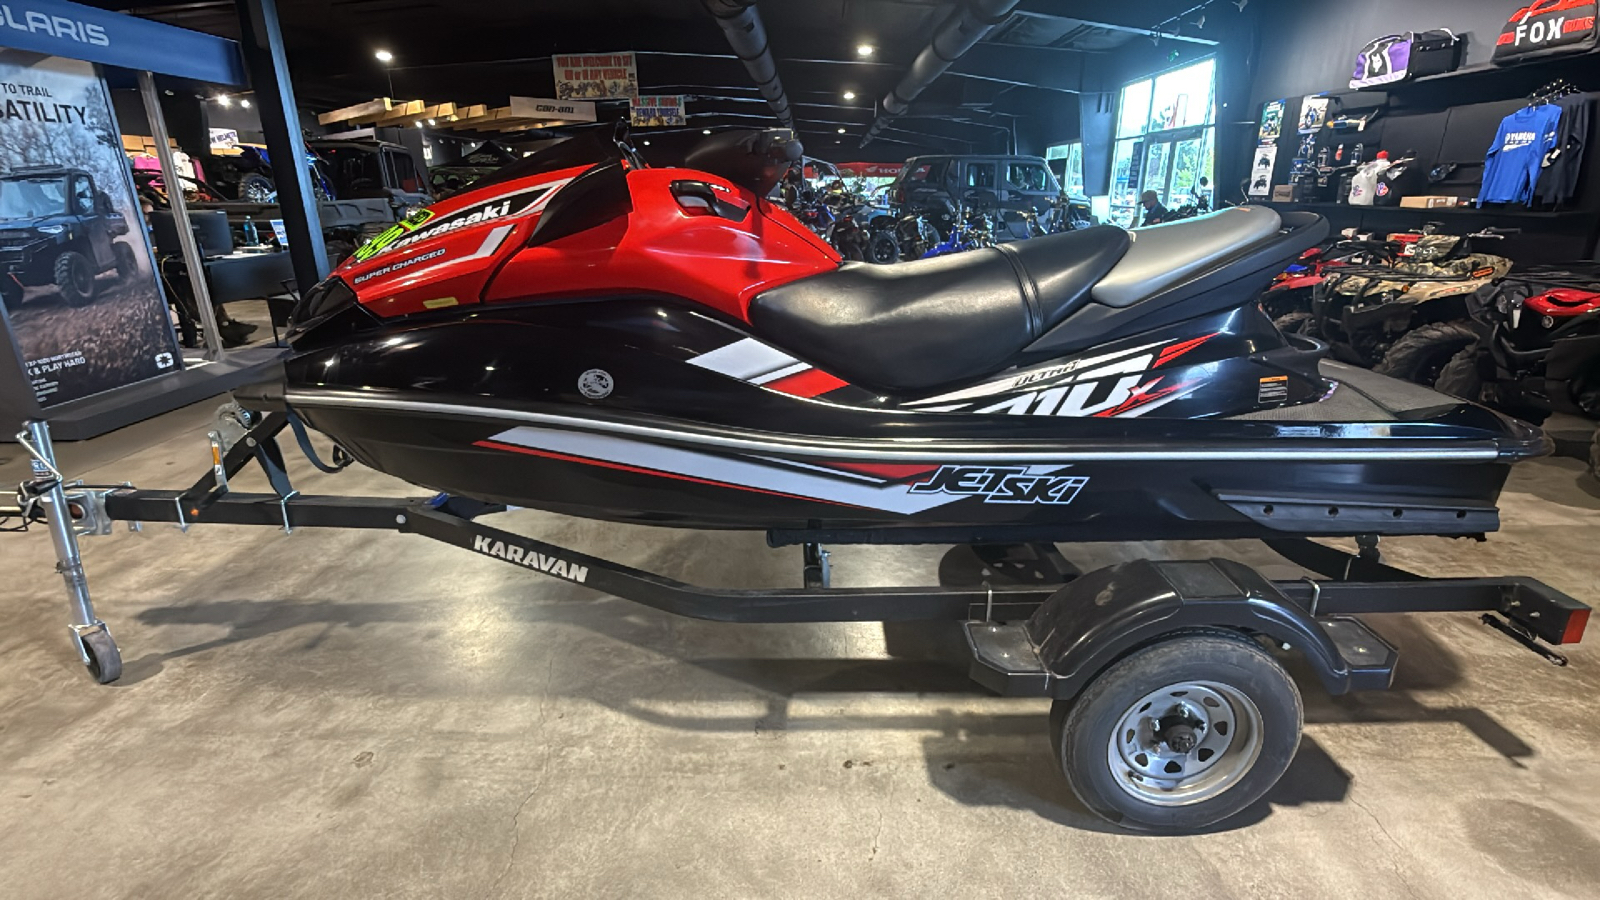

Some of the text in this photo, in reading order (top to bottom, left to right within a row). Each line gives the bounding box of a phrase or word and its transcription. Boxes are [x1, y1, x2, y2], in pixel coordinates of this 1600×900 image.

[0, 4, 110, 47] LARIS
[1514, 16, 1565, 46] FOX
[1, 83, 53, 98] TO TRAIL
[379, 200, 512, 255] Kawasaki
[354, 248, 446, 285] SUPER CHARGED
[473, 534, 589, 583] KARAVAN
